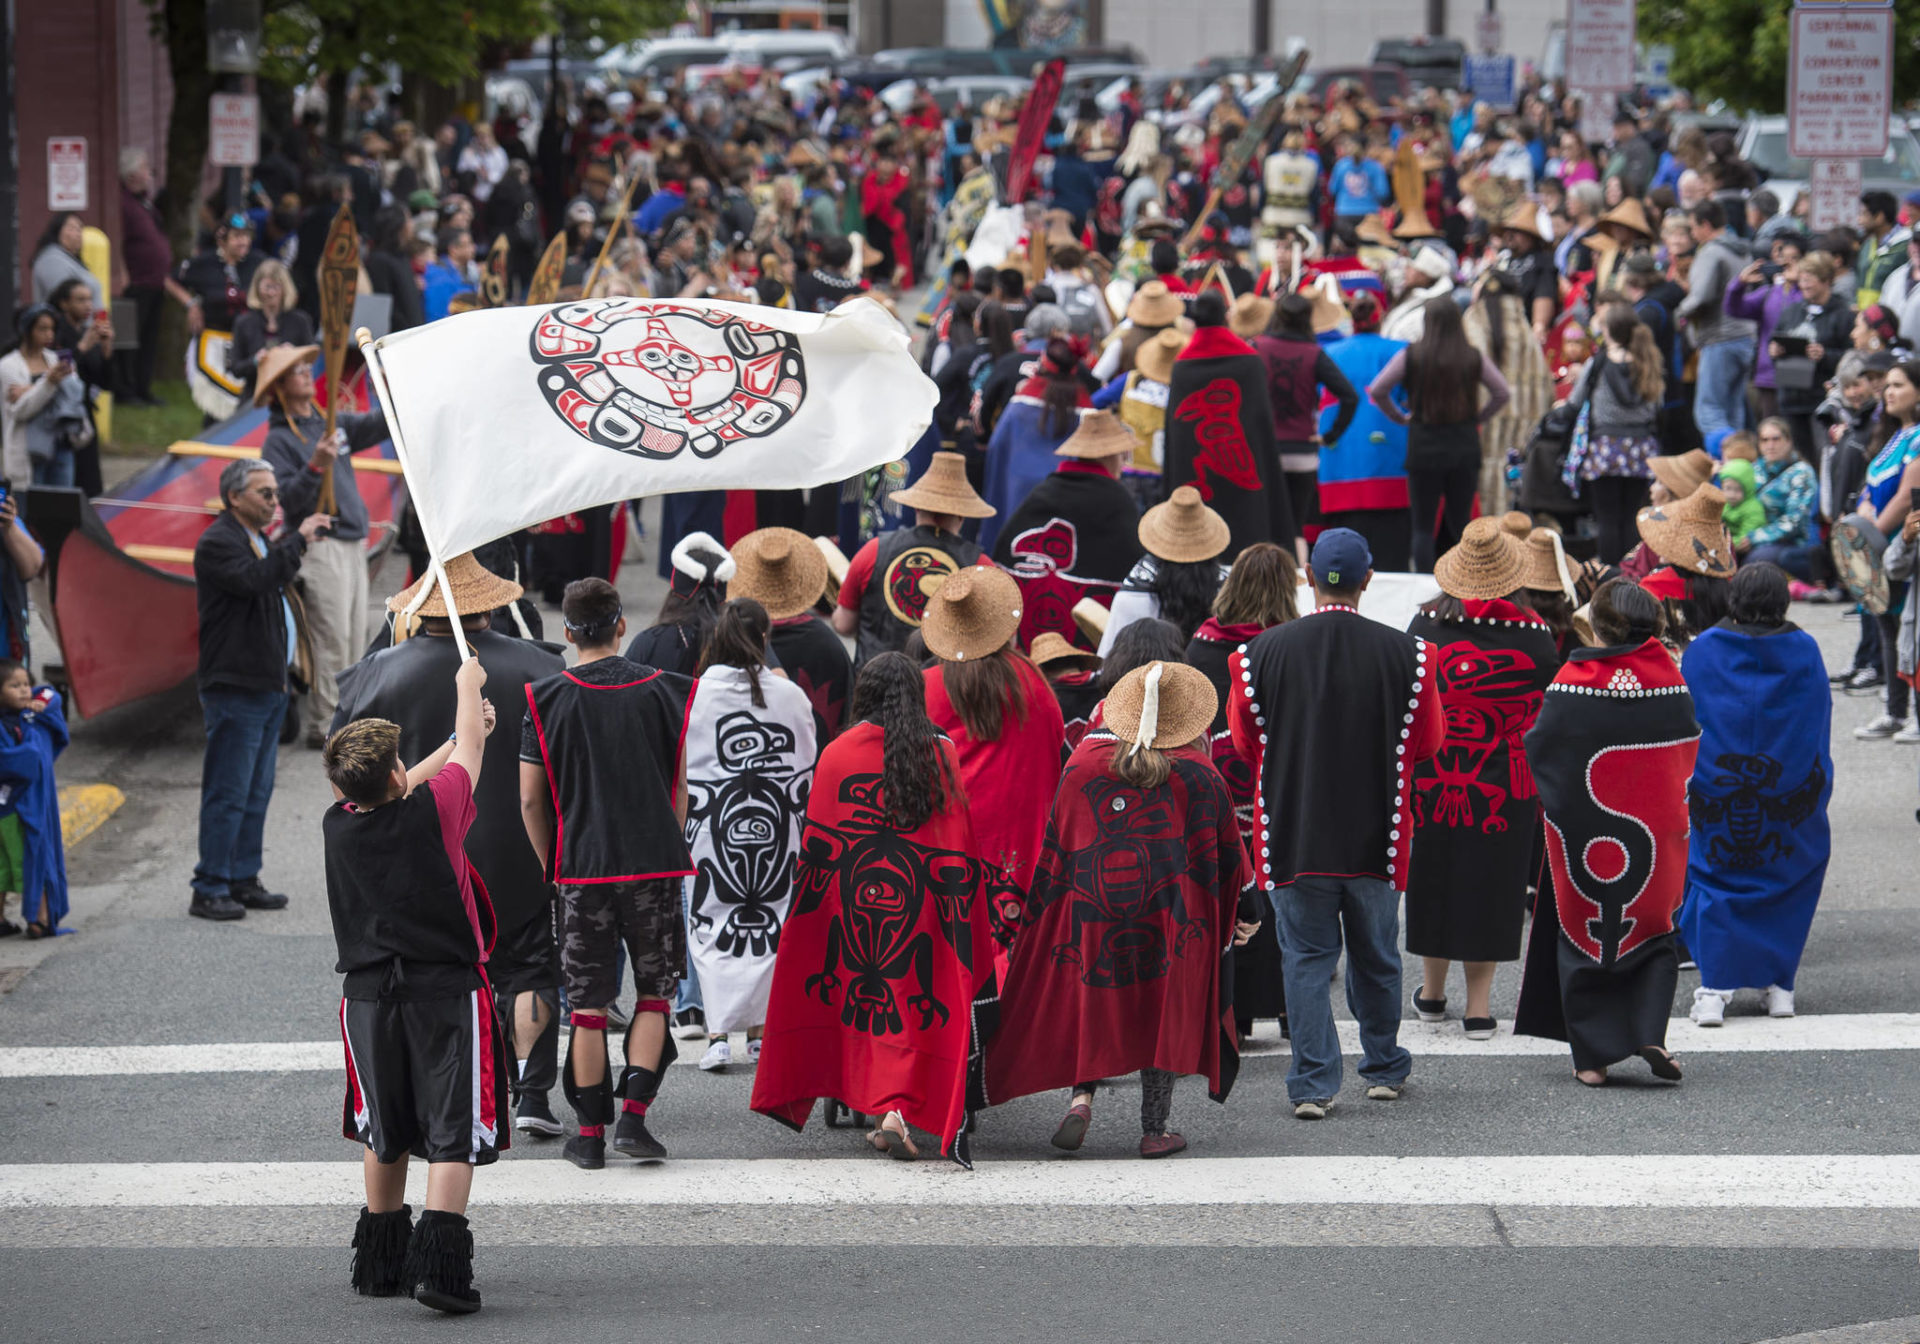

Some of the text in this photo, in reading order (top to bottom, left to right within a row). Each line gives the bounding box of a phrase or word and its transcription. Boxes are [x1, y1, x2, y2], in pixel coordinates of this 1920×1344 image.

[1827, 38, 1856, 50] HALL
[1804, 57, 1881, 69] CONVENTION
[1819, 74, 1864, 86] CENTER
